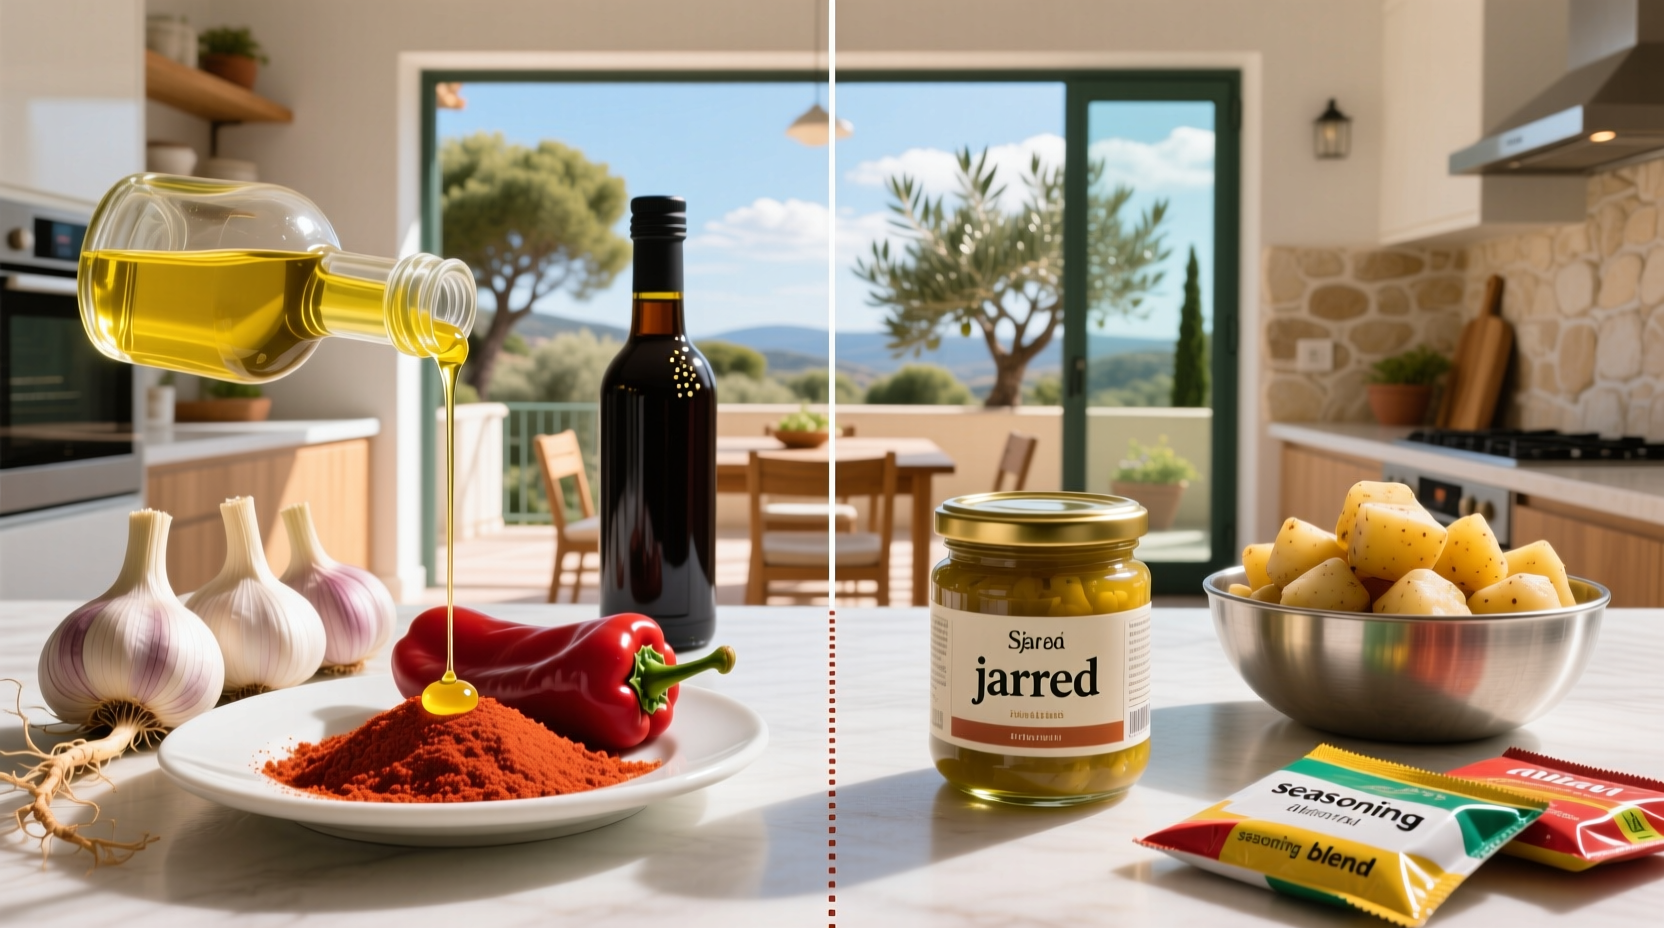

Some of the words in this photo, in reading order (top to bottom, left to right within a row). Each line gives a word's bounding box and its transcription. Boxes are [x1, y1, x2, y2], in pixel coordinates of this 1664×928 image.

[971, 656, 1100, 705] jarred
[1271, 781, 1424, 832] seasoning
[1307, 841, 1376, 877] blend
